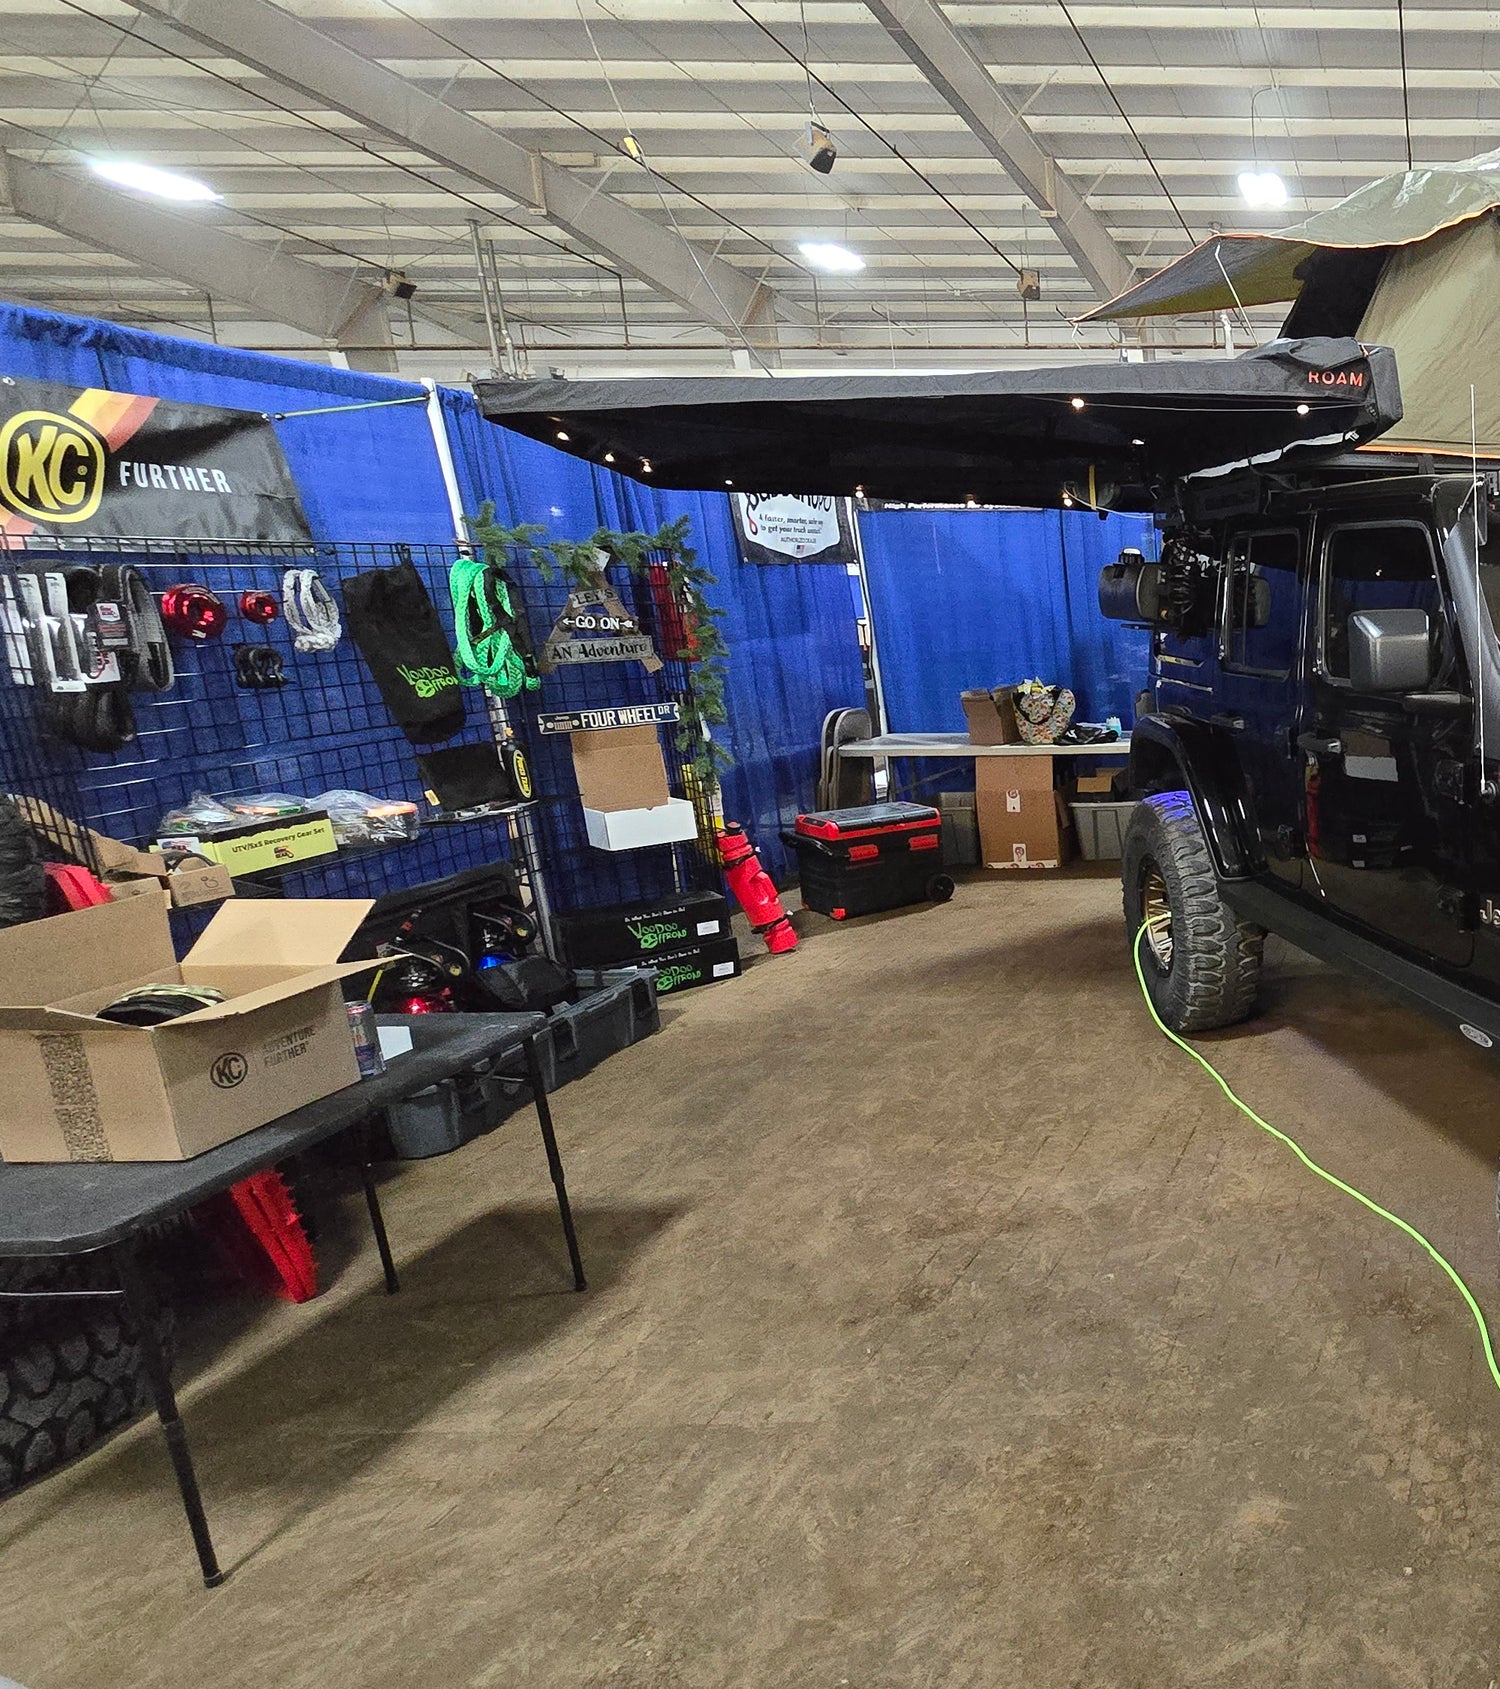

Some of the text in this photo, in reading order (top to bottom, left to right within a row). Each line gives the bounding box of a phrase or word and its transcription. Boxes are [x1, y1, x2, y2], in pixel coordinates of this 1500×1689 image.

[1308, 371, 1363, 387] ROAM
[15, 426, 88, 511] KC
[119, 461, 232, 494] FURTHER
[575, 616, 620, 630] GO ON
[552, 642, 648, 660] AN Adventure
[580, 705, 670, 728] FOUR WHEEL DR
[264, 833, 296, 847] Recovery
[313, 828, 325, 836] Set
[215, 1056, 242, 1084] KC
